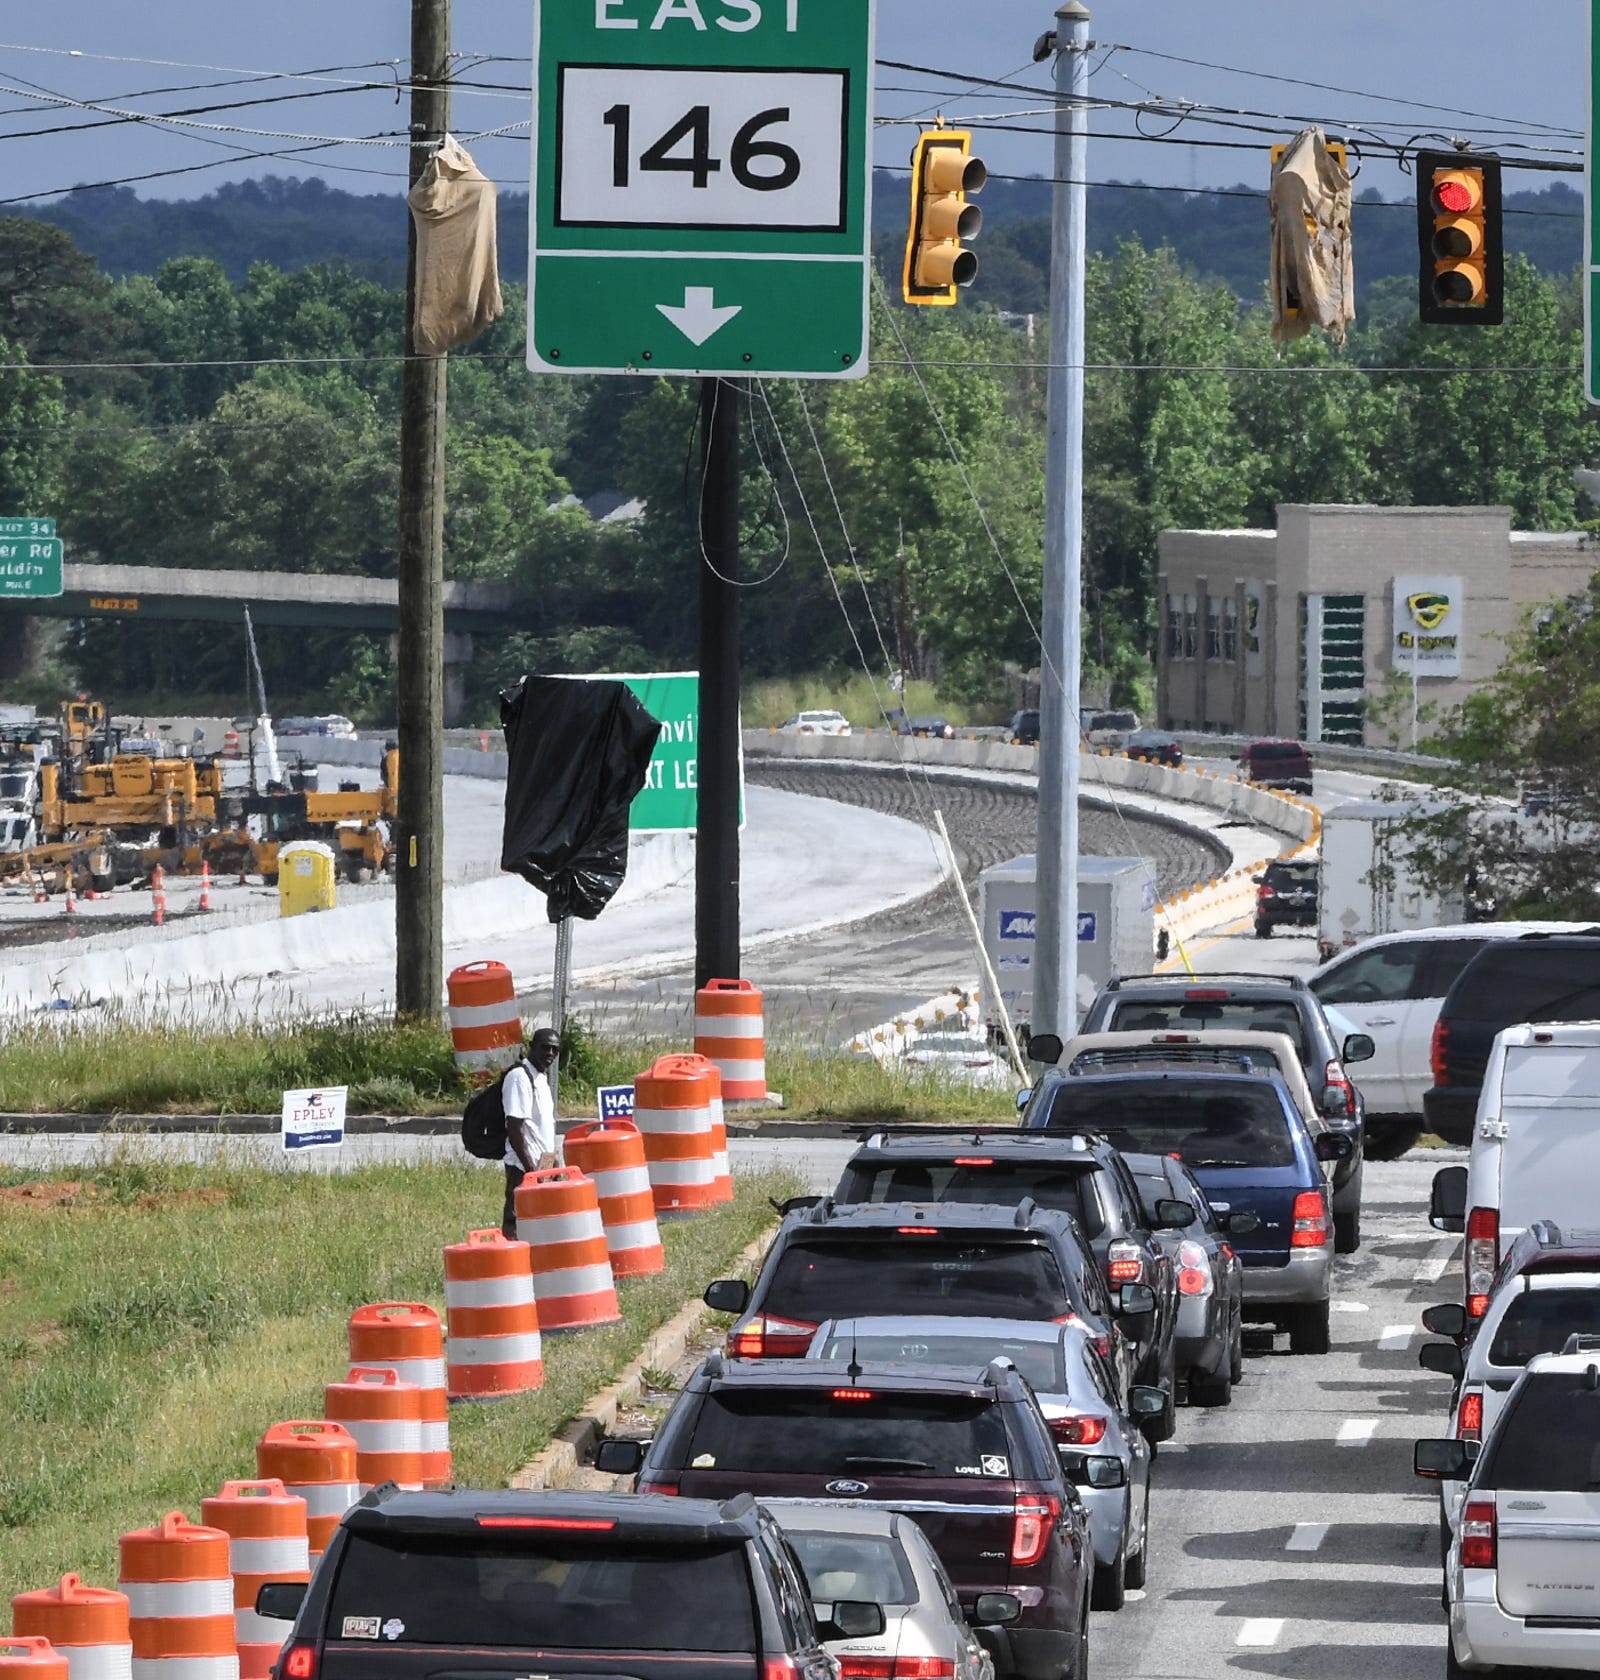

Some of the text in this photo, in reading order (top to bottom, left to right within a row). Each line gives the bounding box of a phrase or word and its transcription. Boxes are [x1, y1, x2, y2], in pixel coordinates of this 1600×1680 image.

[603, 104, 801, 191] 146
[30, 521, 49, 535] 34
[29, 543, 53, 559] Rd
[293, 1107, 335, 1121] EPLEY
[1526, 1582, 1595, 1591] PLATINUM
